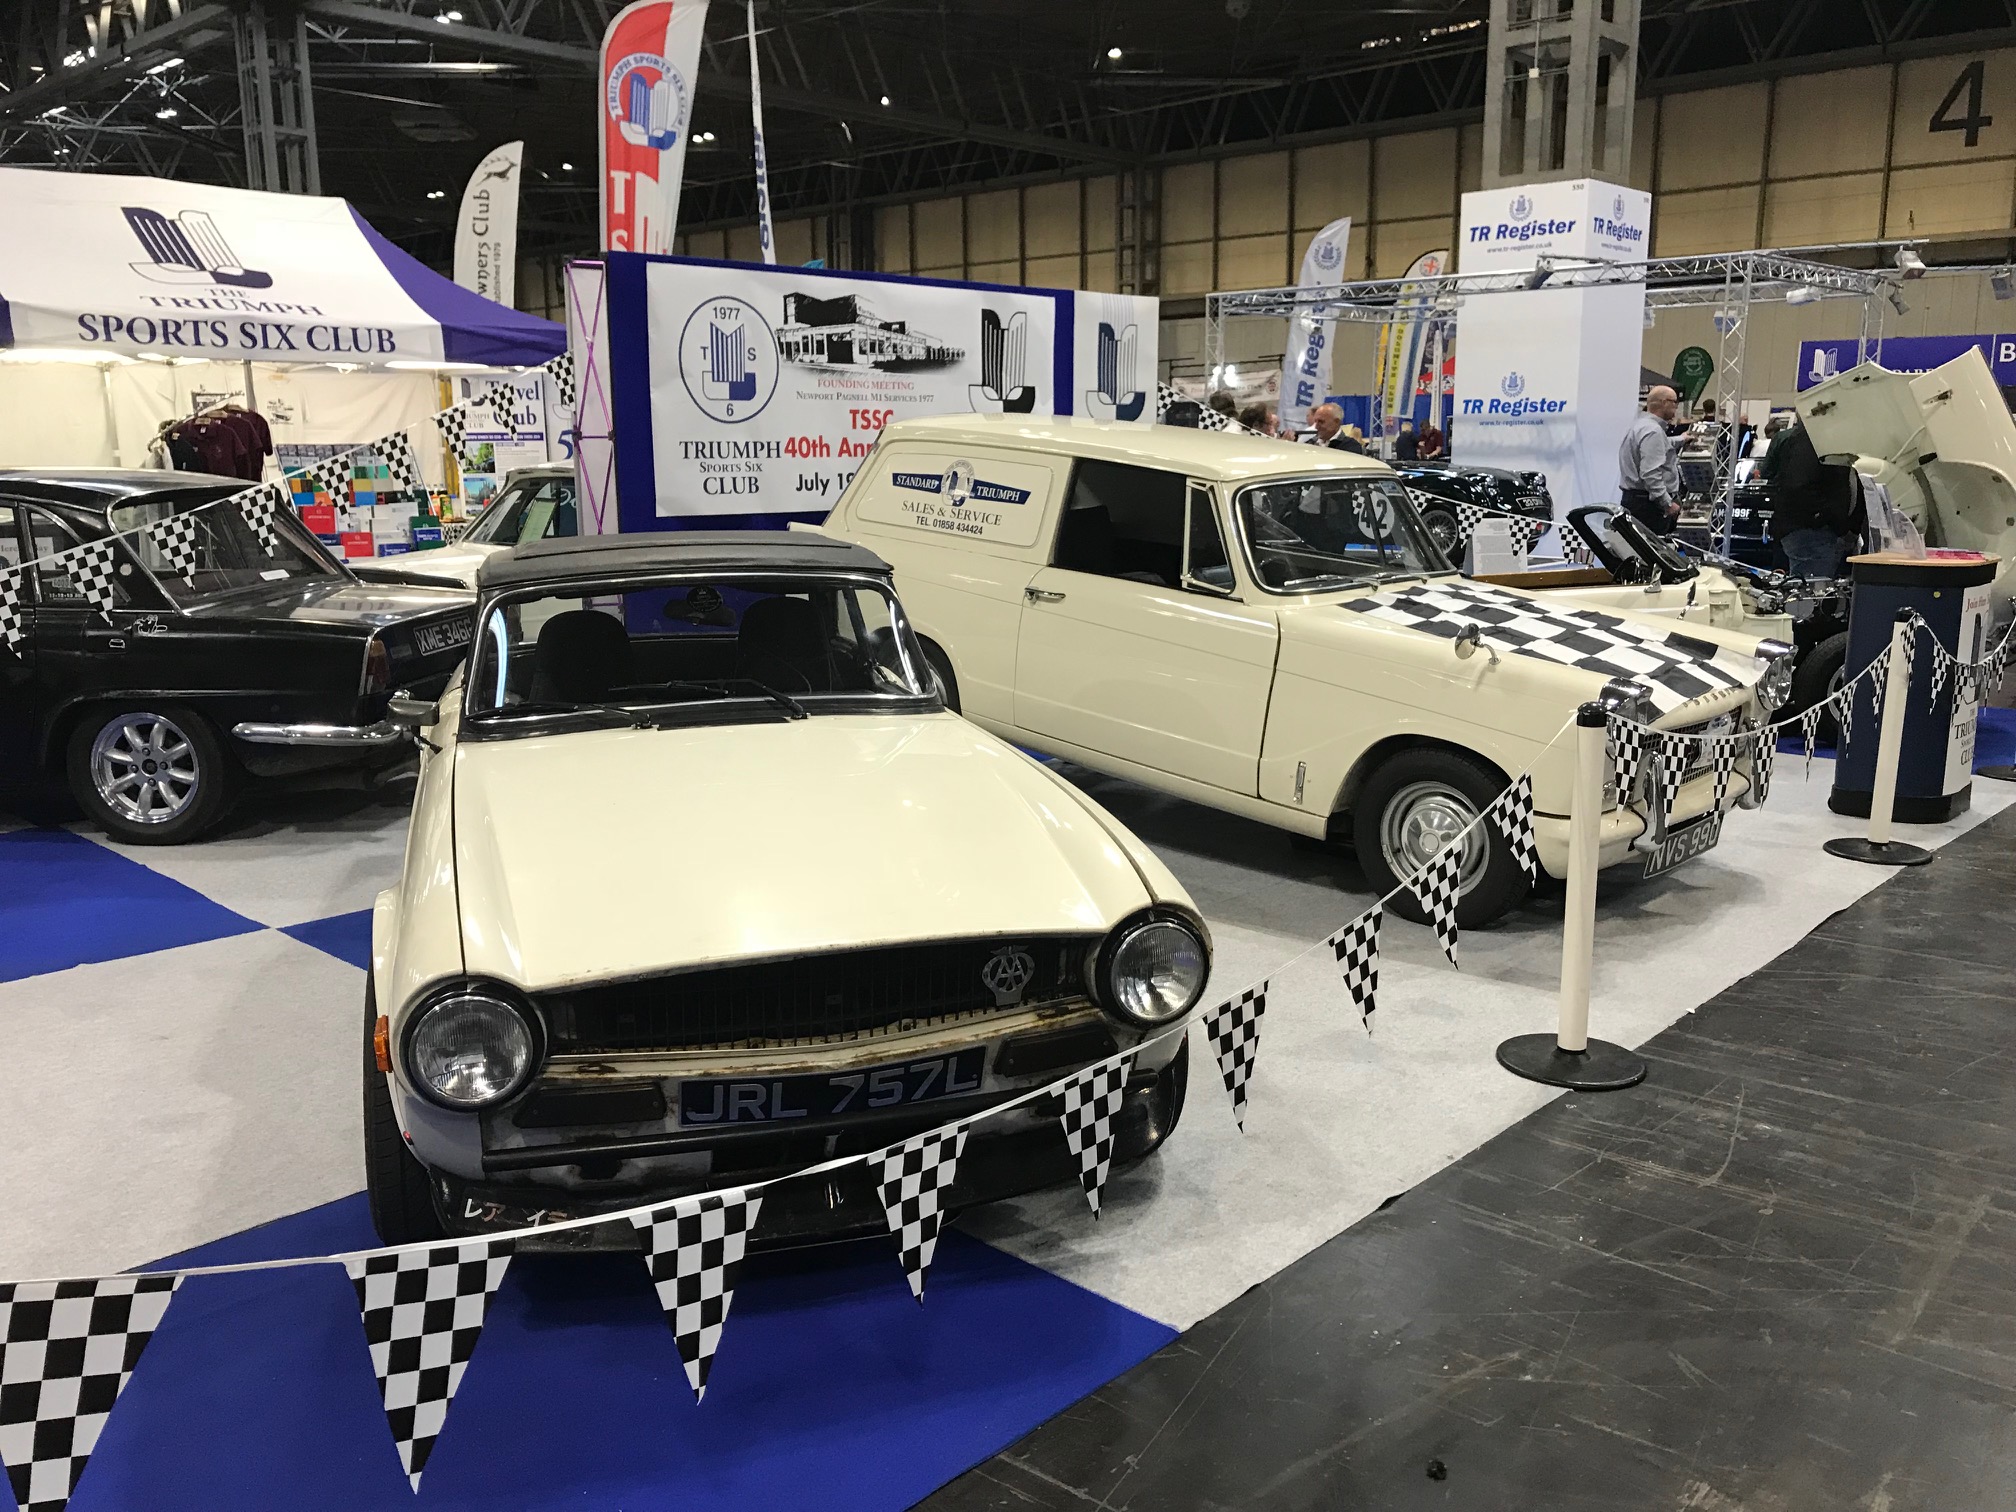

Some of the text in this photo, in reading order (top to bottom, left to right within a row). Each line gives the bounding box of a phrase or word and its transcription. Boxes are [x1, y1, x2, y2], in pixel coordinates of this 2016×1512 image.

[1929, 60, 1993, 147] 4
[472, 189, 491, 237] Club
[1470, 219, 1577, 243] TR Register
[1594, 216, 1642, 242] TR Register
[1486, 241, 1553, 253] www.tr-register.co.uk
[204, 287, 250, 298] THE
[139, 294, 327, 317] TRIUMPH
[713, 305, 741, 320] 1977
[77, 312, 397, 354] SPORTS SIX CLUB
[700, 345, 758, 362] T S
[485, 380, 540, 401] Tvel
[817, 378, 915, 390] FOUNDING MEETING
[1295, 380, 1315, 408] TR
[918, 394, 935, 403] 1977
[1462, 397, 1568, 417] TR Register
[493, 405, 538, 426] Cub
[725, 402, 735, 417] 6
[849, 408, 894, 430] TSSC
[1479, 419, 1544, 427] www.tr-register.co.uk
[679, 440, 782, 460] TRIUMPH
[784, 435, 831, 459] 40th
[702, 476, 760, 495] CLUB
[796, 472, 830, 496] July
[896, 474, 940, 490] STANDARD
[976, 485, 1021, 502] TRIUMPH
[901, 500, 1003, 526] SALES & SERVICE
[932, 518, 955, 531] 01858
[956, 522, 984, 535] 434424
[1649, 832, 1688, 872] NVS
[685, 1056, 979, 1122] JRL 757L
